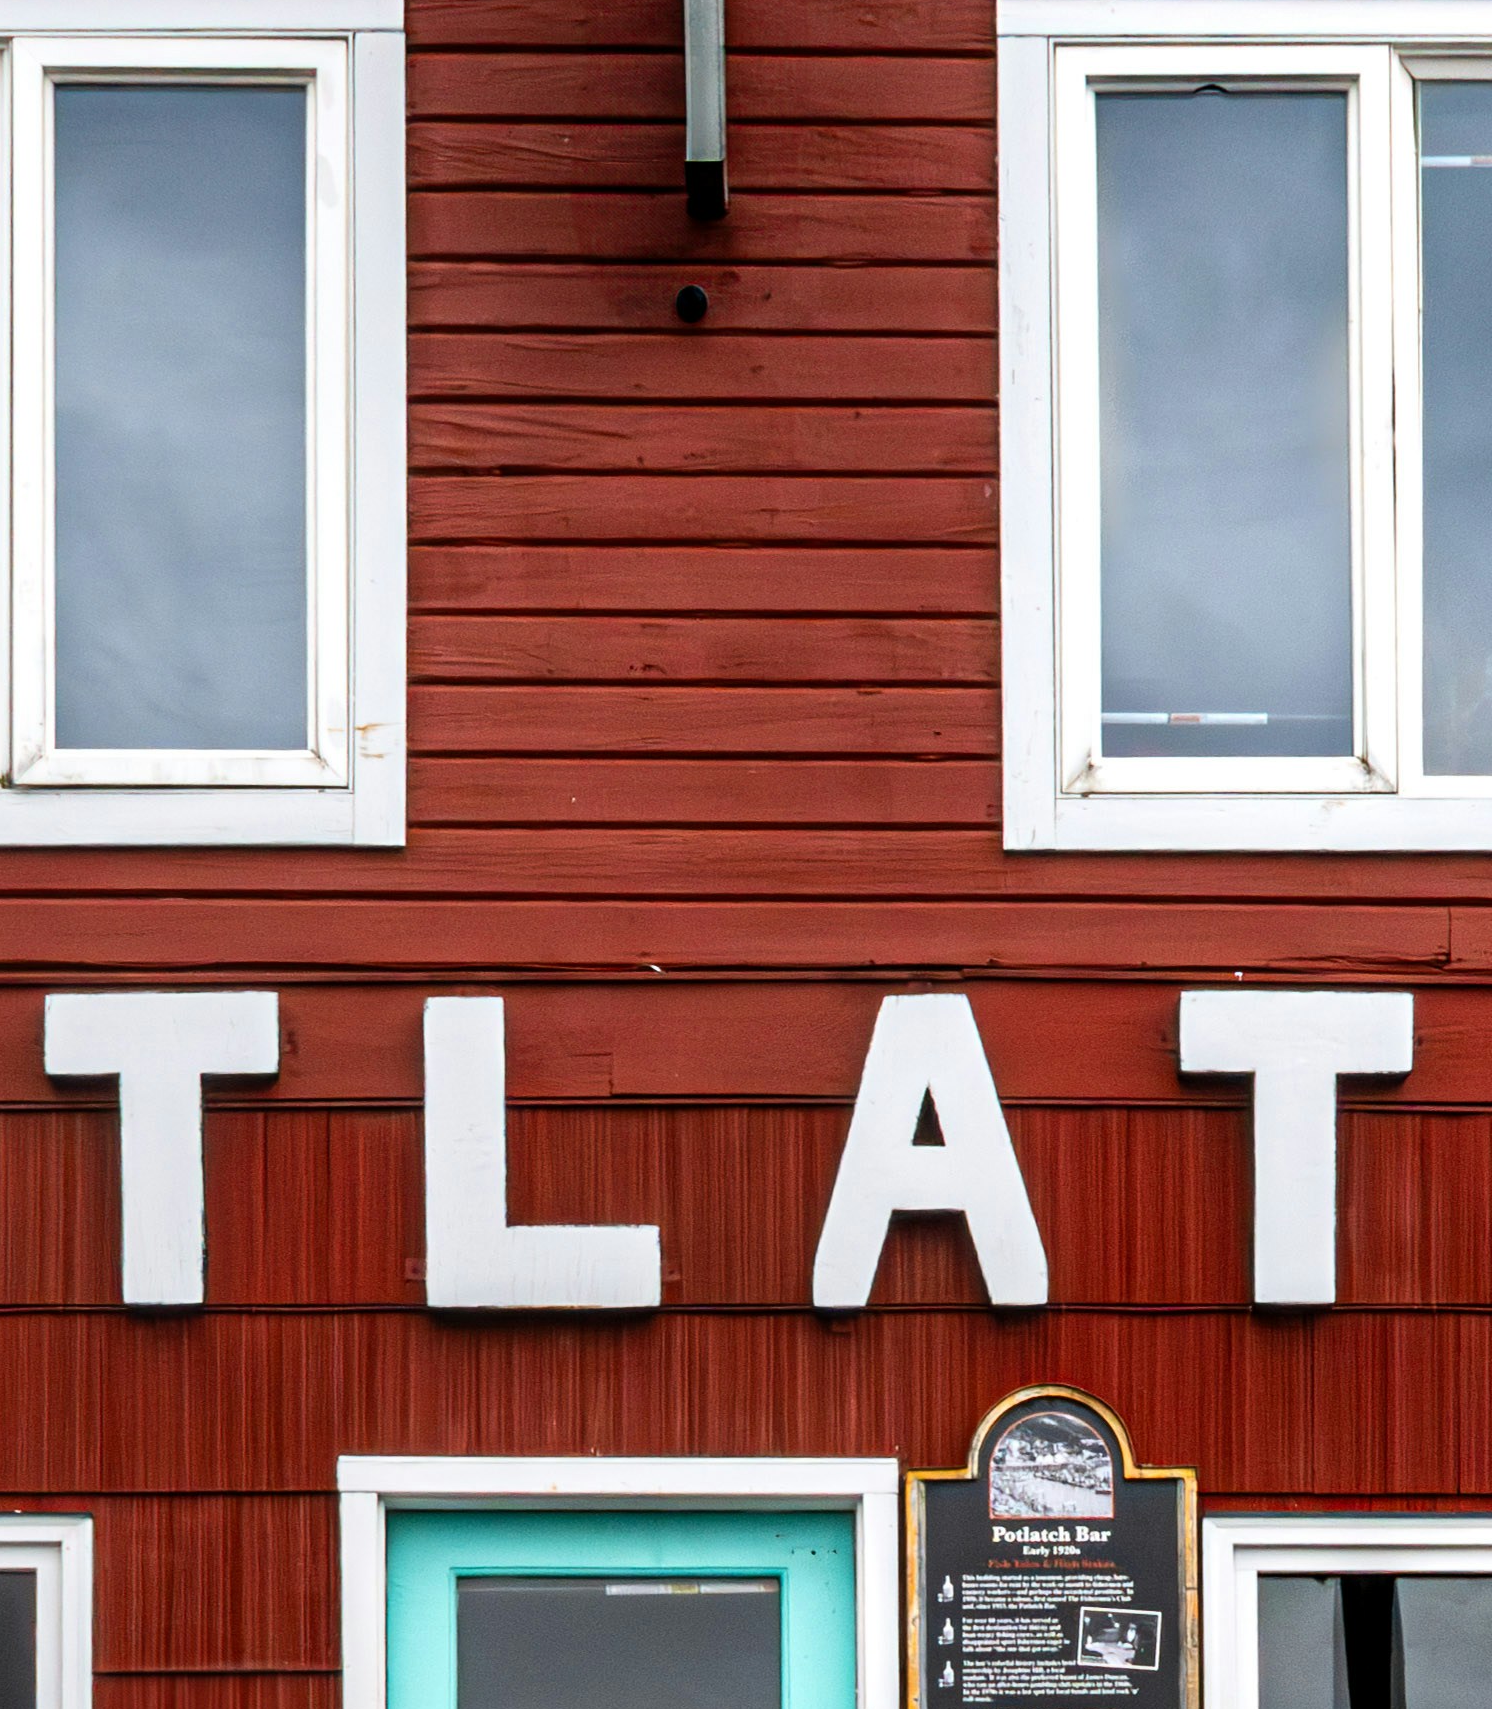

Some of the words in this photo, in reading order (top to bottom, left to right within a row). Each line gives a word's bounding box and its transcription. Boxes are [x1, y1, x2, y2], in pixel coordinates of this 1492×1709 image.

[991, 1525, 1072, 1543] Potlatch
[1074, 1525, 1112, 1543] Bar
[1022, 1544, 1051, 1558] Early
